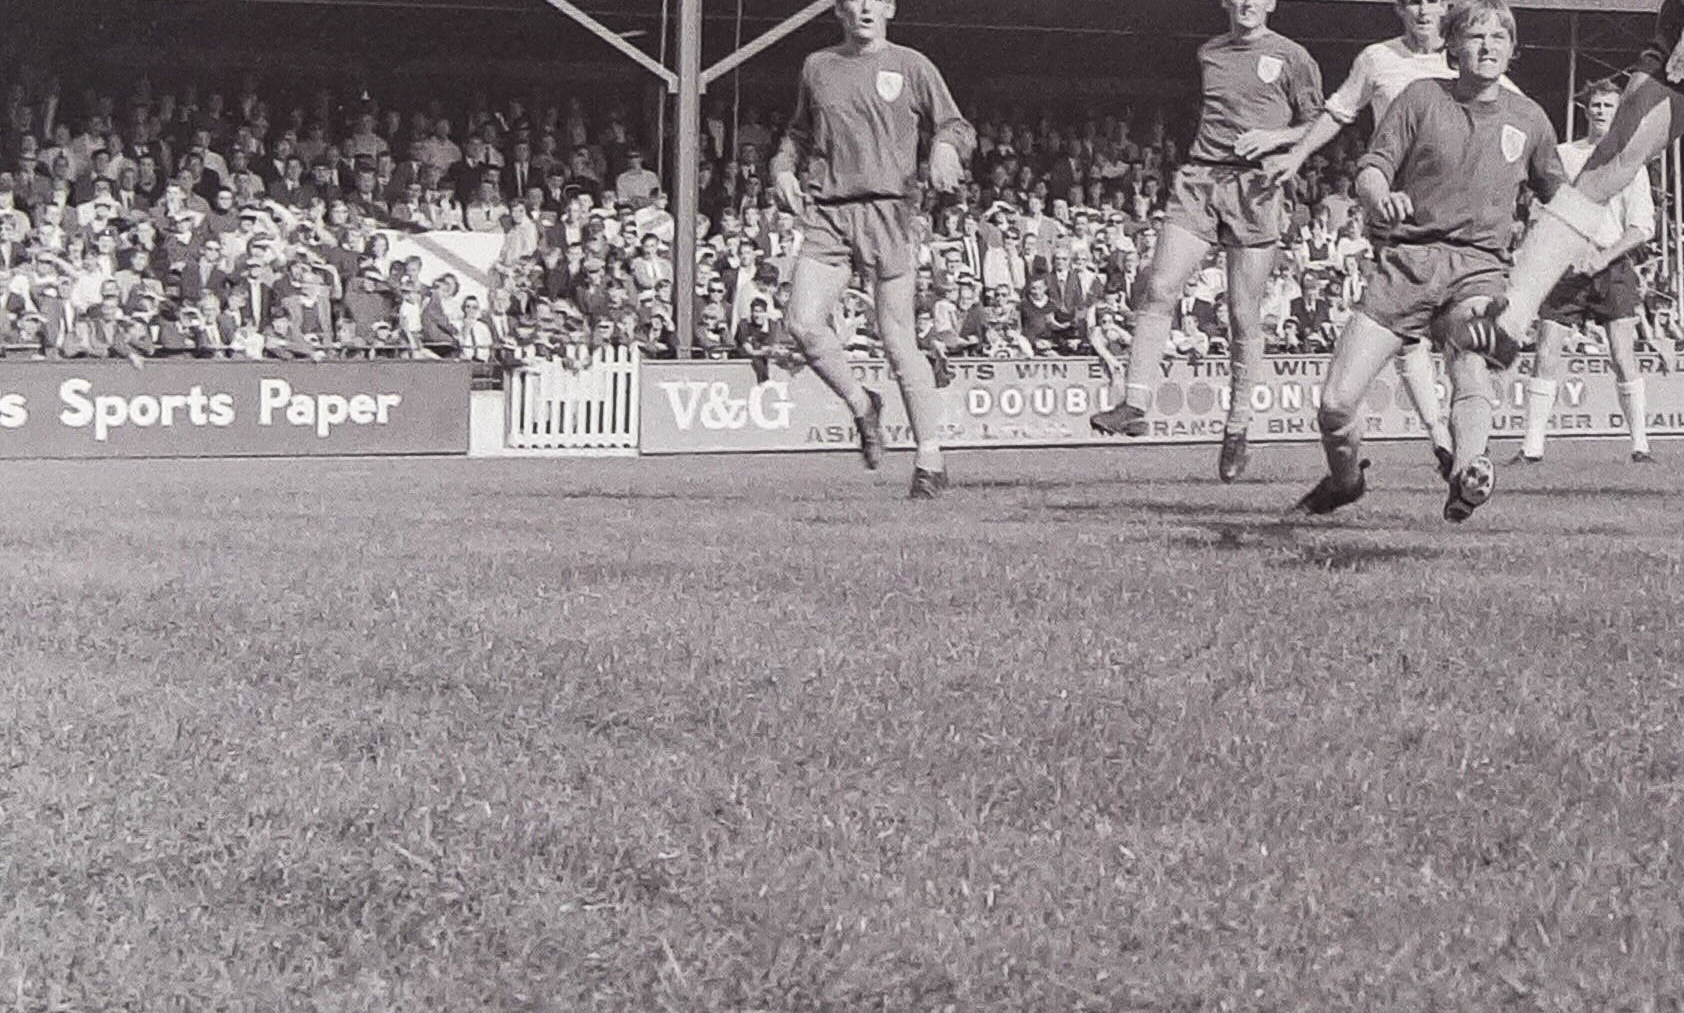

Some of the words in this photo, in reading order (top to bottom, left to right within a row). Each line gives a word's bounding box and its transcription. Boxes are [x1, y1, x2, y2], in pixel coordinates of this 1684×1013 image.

[1014, 362, 1069, 379] WIN
[1273, 359, 1328, 376] WIT
[59, 378, 235, 442] Sports
[258, 378, 402, 437] Paper
[661, 380, 795, 431] V&G
[968, 388, 1115, 416] DOUBL
